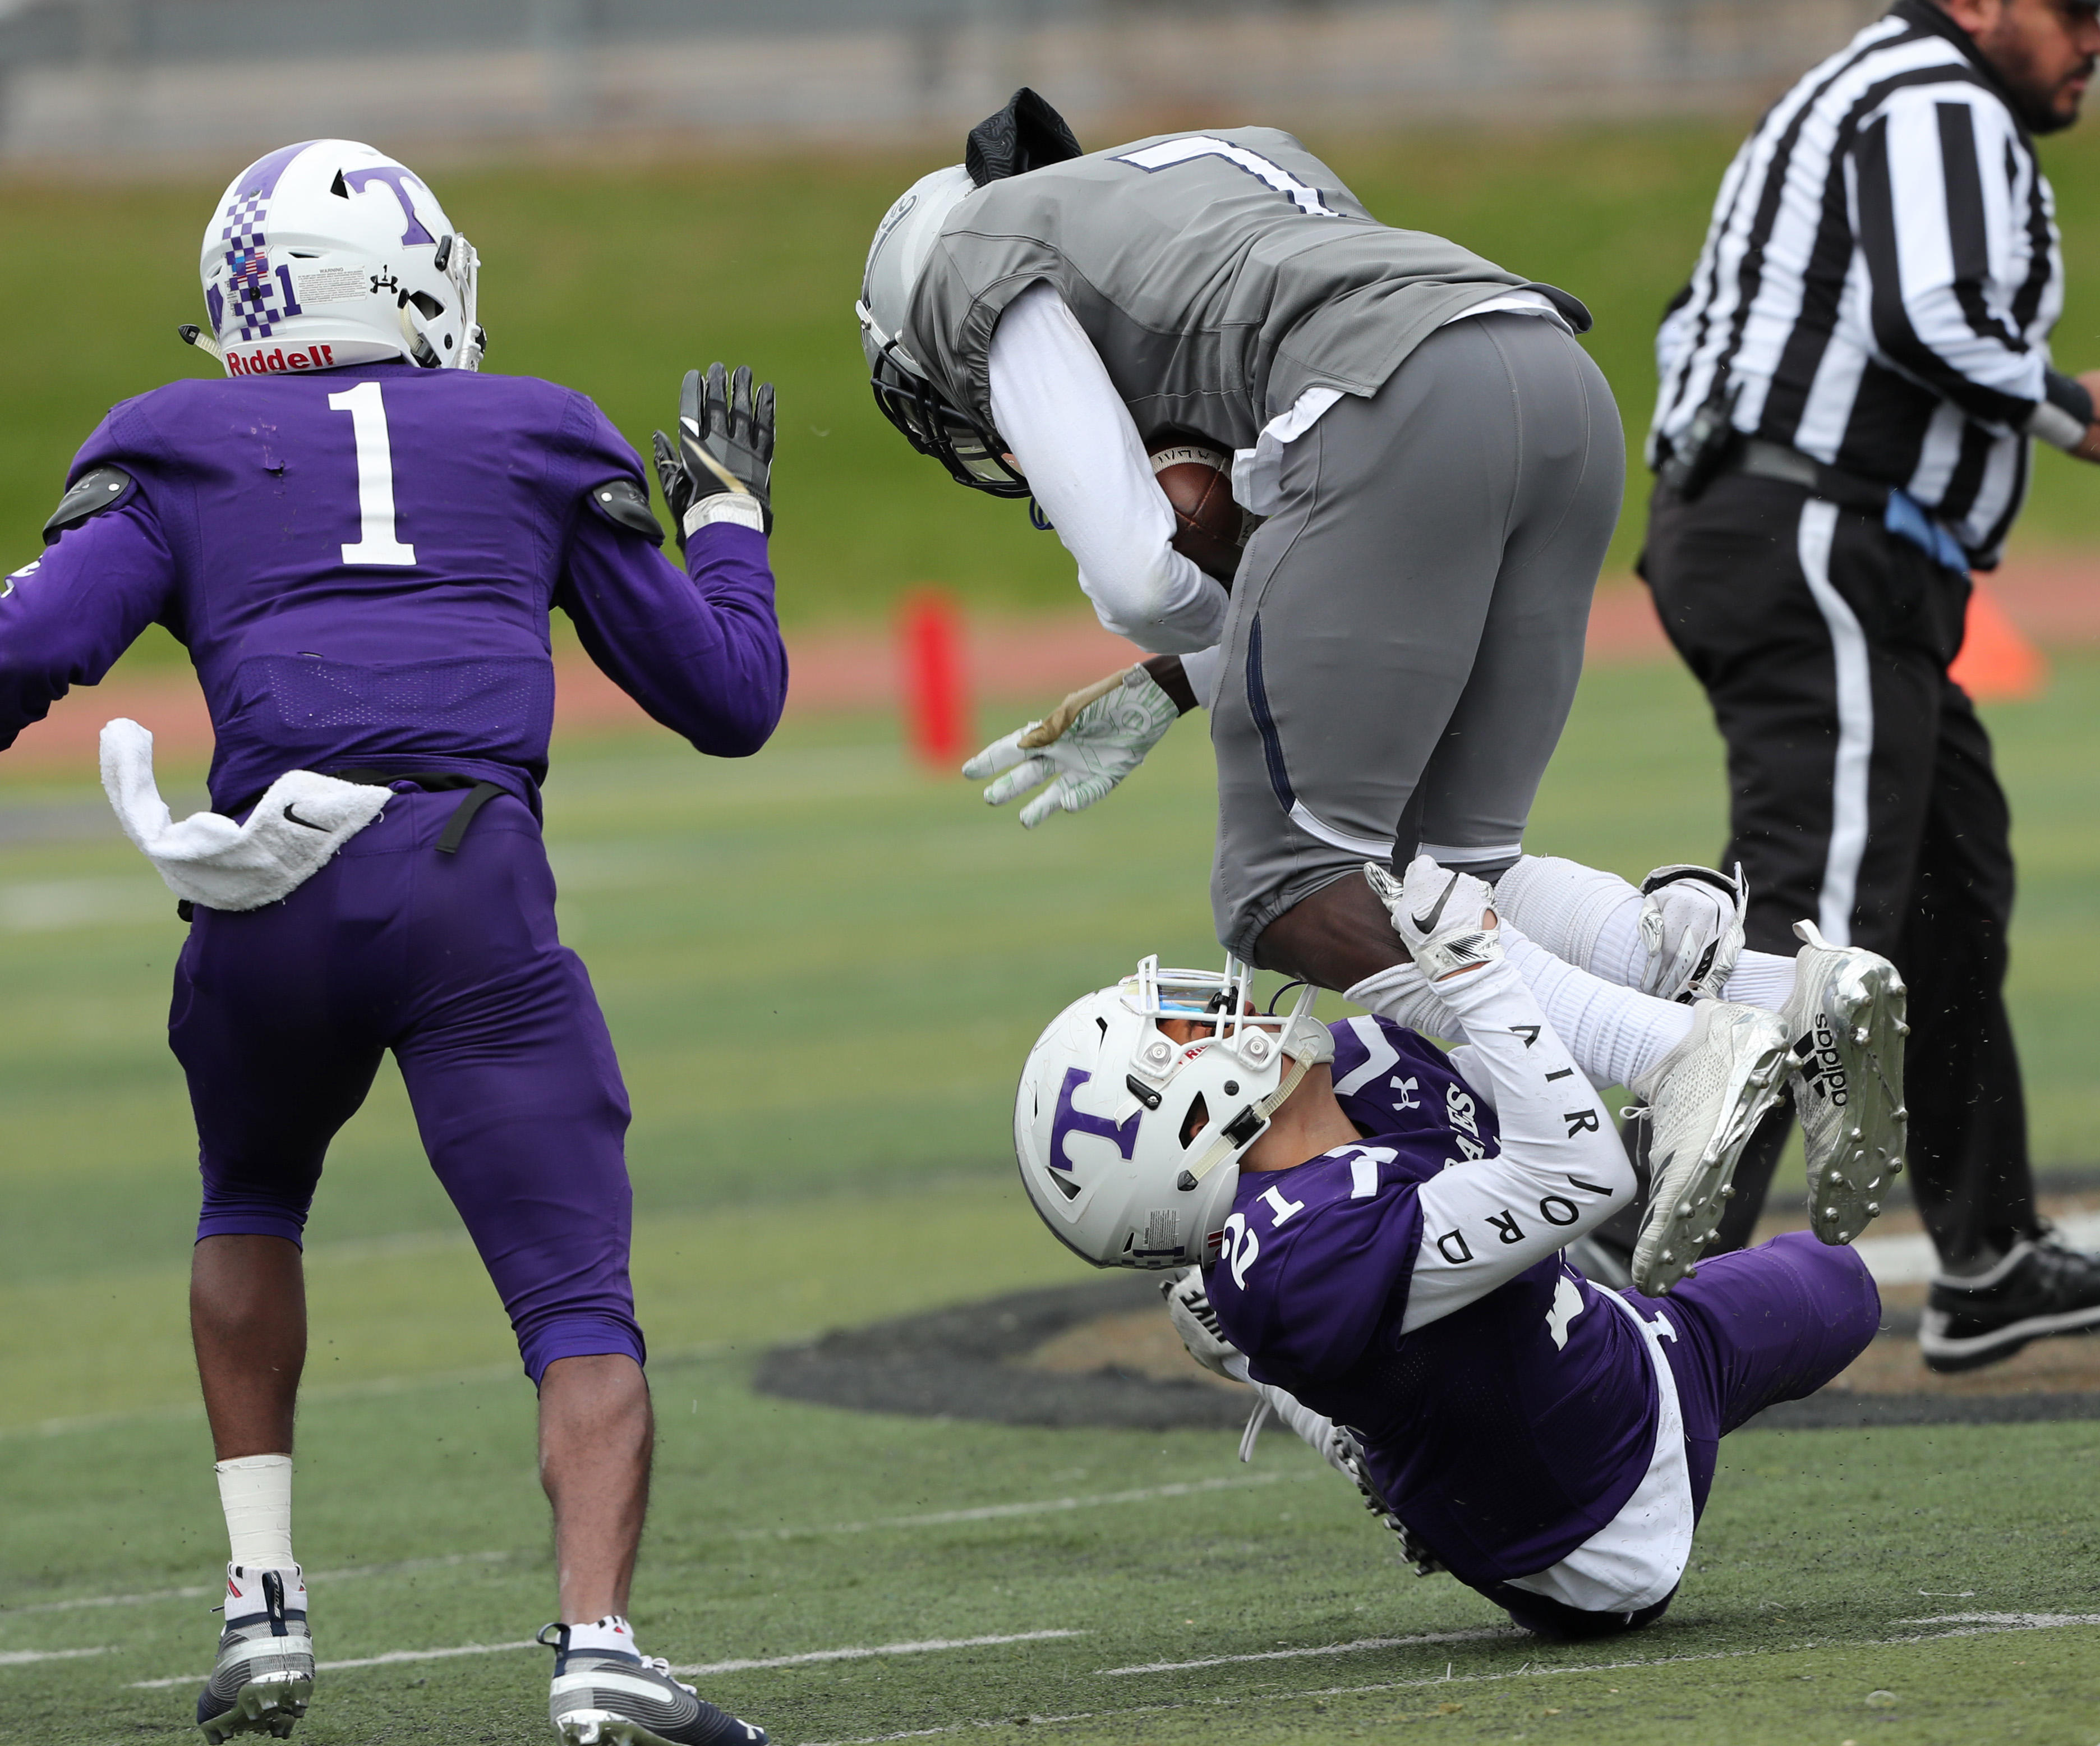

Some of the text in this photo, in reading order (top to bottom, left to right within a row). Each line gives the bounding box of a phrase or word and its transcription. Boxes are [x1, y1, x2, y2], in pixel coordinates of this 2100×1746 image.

[340, 166, 437, 249] T
[275, 264, 303, 317] 1
[226, 344, 335, 377] Riddell
[328, 382, 417, 566] 1
[1816, 1013, 1848, 1107] adidas
[1047, 1065, 1144, 1174] T
[1221, 1184, 1306, 1291] 21
